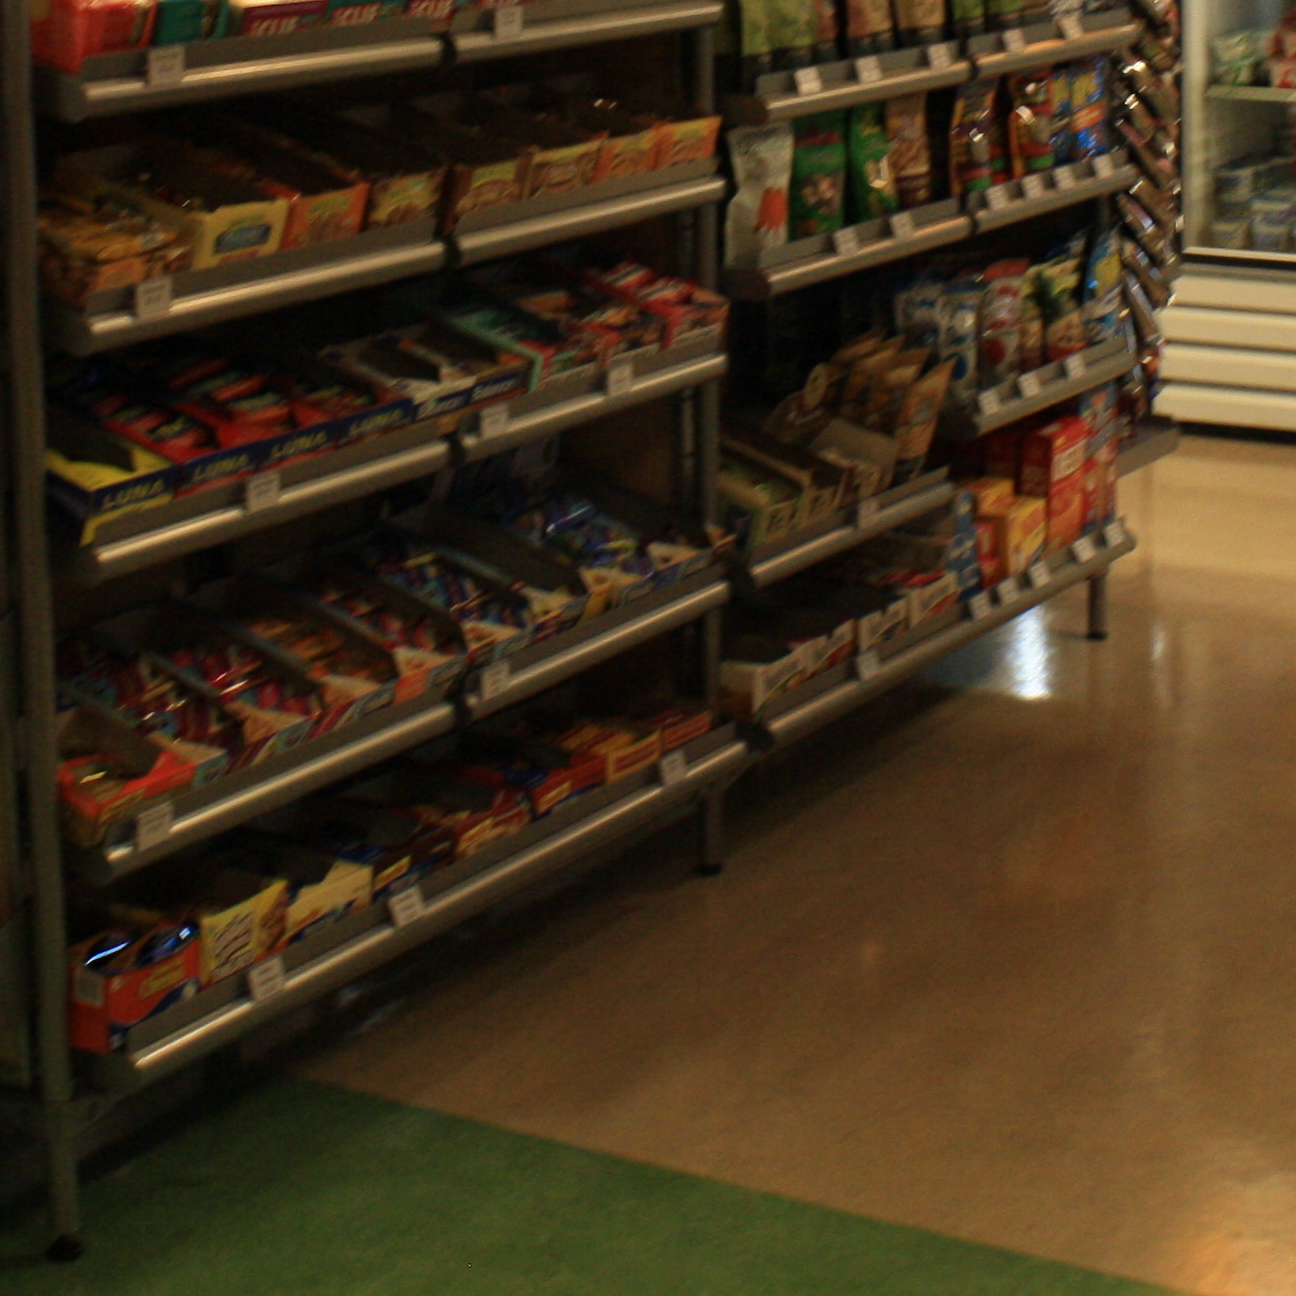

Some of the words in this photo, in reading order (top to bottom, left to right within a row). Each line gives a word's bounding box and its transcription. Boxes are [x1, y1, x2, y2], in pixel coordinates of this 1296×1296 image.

[347, 406, 404, 437] LUNA
[268, 429, 330, 459] LUNA
[189, 452, 250, 481] LUNA
[104, 478, 166, 508] LUNA
